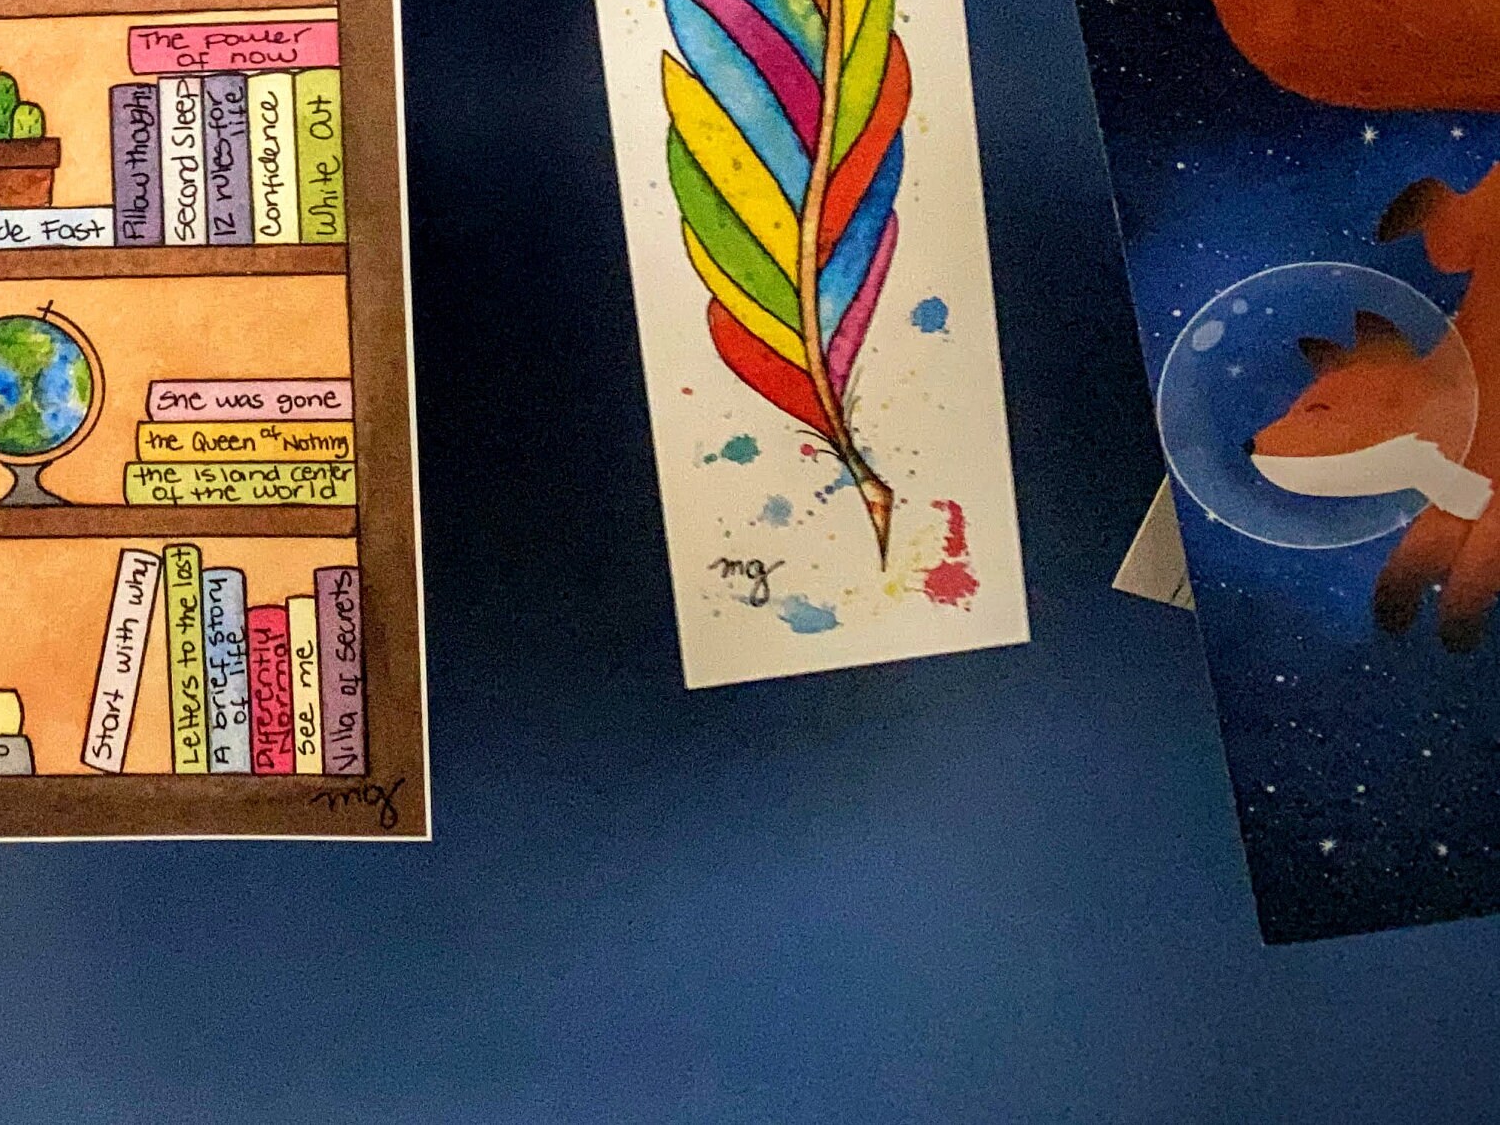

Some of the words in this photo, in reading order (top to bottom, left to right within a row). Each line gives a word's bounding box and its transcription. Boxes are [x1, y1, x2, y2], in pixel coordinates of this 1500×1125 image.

[139, 31, 189, 50] The
[205, 28, 312, 49] power
[177, 52, 209, 68] of
[231, 49, 297, 64] now
[226, 86, 246, 136] life
[211, 138, 234, 201] rules
[258, 91, 284, 236] Confidence
[123, 173, 150, 240] Pillow
[214, 213, 236, 236] 12
[41, 218, 105, 241] Fast
[216, 393, 264, 408] was
[277, 391, 341, 414] gone
[146, 431, 183, 450] the
[192, 431, 256, 451] Queen
[260, 425, 282, 440] of
[284, 433, 349, 458] Nothing
[133, 466, 181, 485] the
[290, 464, 352, 481] center
[153, 486, 183, 506] of
[191, 485, 240, 502] the
[253, 482, 337, 500] world
[125, 558, 156, 605] why
[170, 549, 192, 587] lost
[177, 596, 197, 634] the
[209, 578, 228, 646] story
[116, 618, 139, 673] with
[178, 641, 195, 667] to
[227, 626, 248, 675] life
[296, 640, 314, 688] me
[341, 674, 364, 696] of
[178, 676, 200, 765] Letters
[234, 698, 248, 724] of
[214, 747, 231, 763] A
[330, 708, 358, 771] Villa
